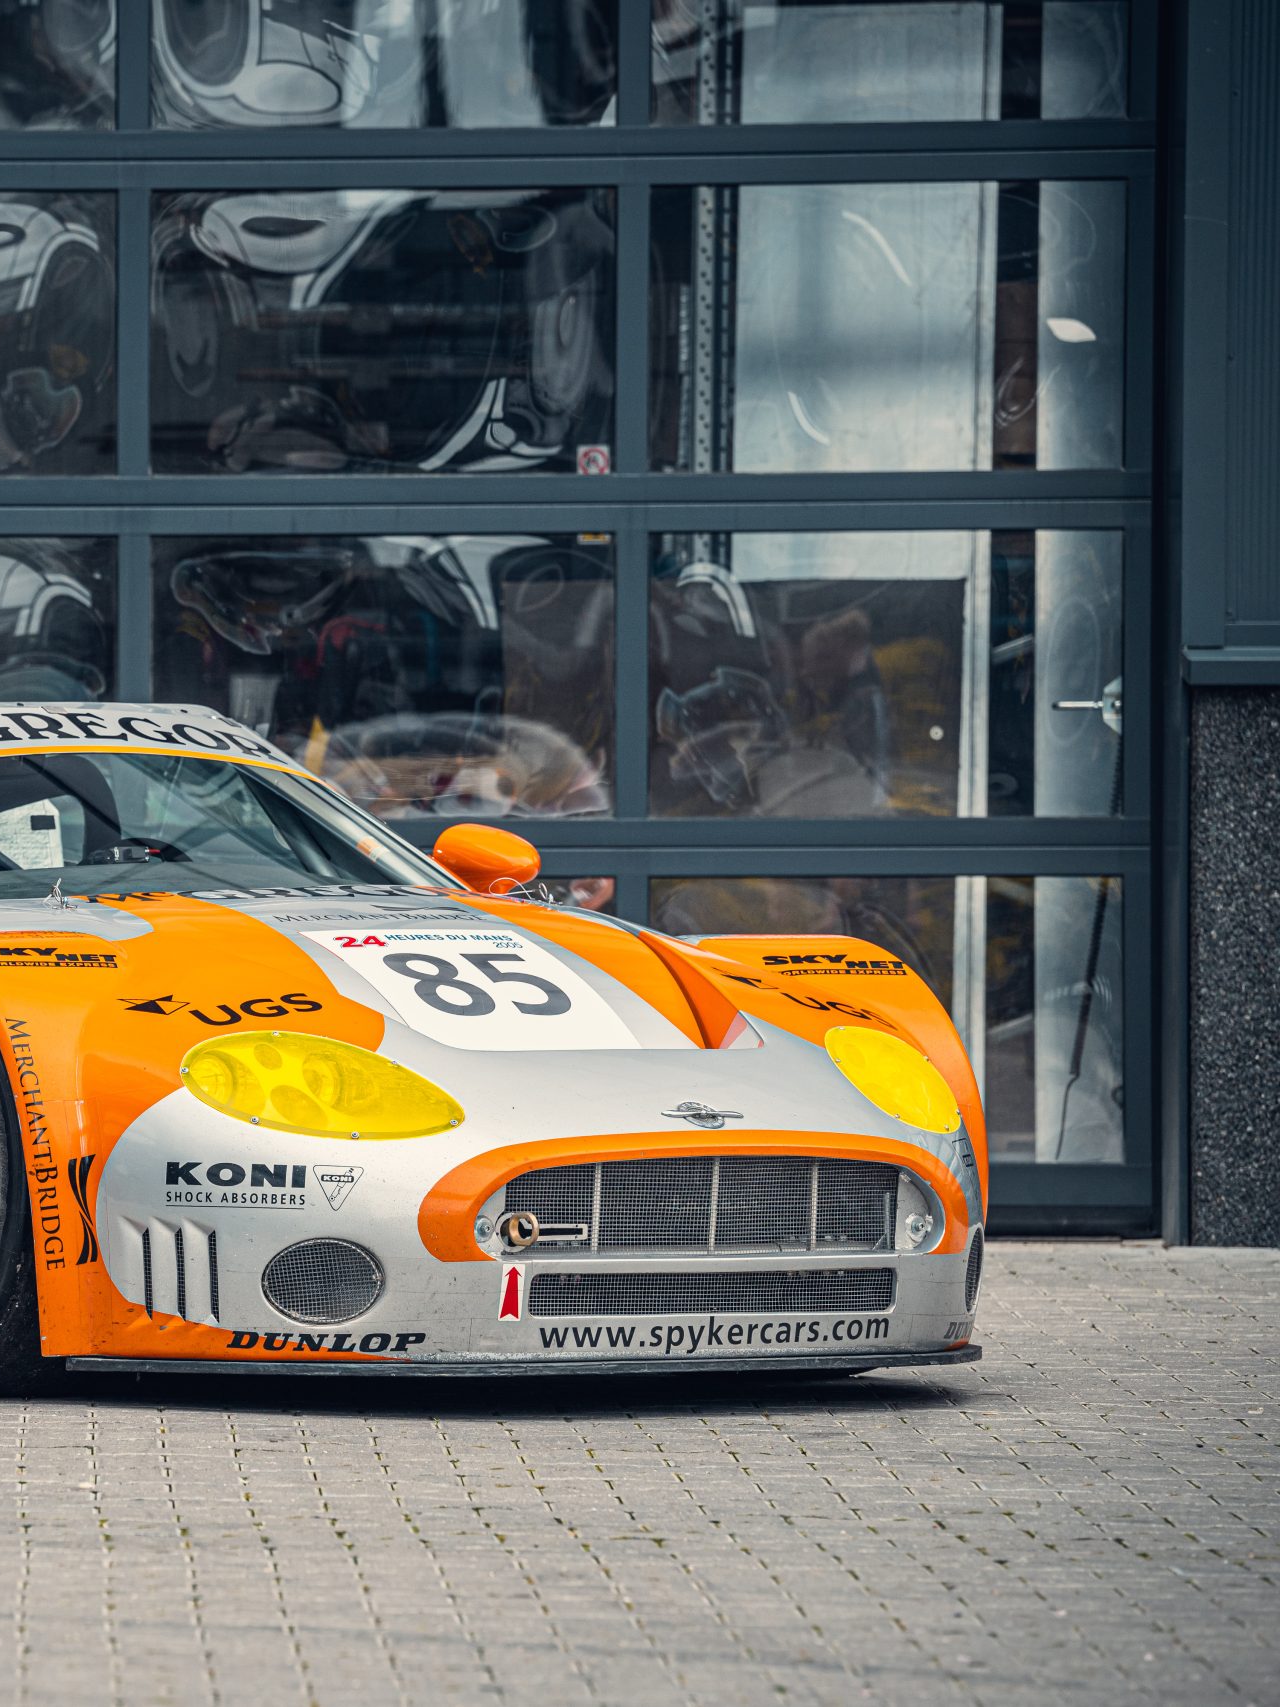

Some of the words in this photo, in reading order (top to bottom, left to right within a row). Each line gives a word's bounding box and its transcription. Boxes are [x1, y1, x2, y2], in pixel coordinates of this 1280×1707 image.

[333, 934, 389, 949] 24
[468, 934, 513, 942] MANS
[492, 941, 523, 949] 2005
[382, 953, 572, 1016] 85
[188, 992, 323, 1026] UGS
[165, 1161, 307, 1189] KONI
[166, 1191, 213, 1204] SHOCK
[221, 1192, 306, 1206] ABSORBERS
[227, 1331, 426, 1353] DUNLOP
[539, 1316, 890, 1354] www.spykercars.com
